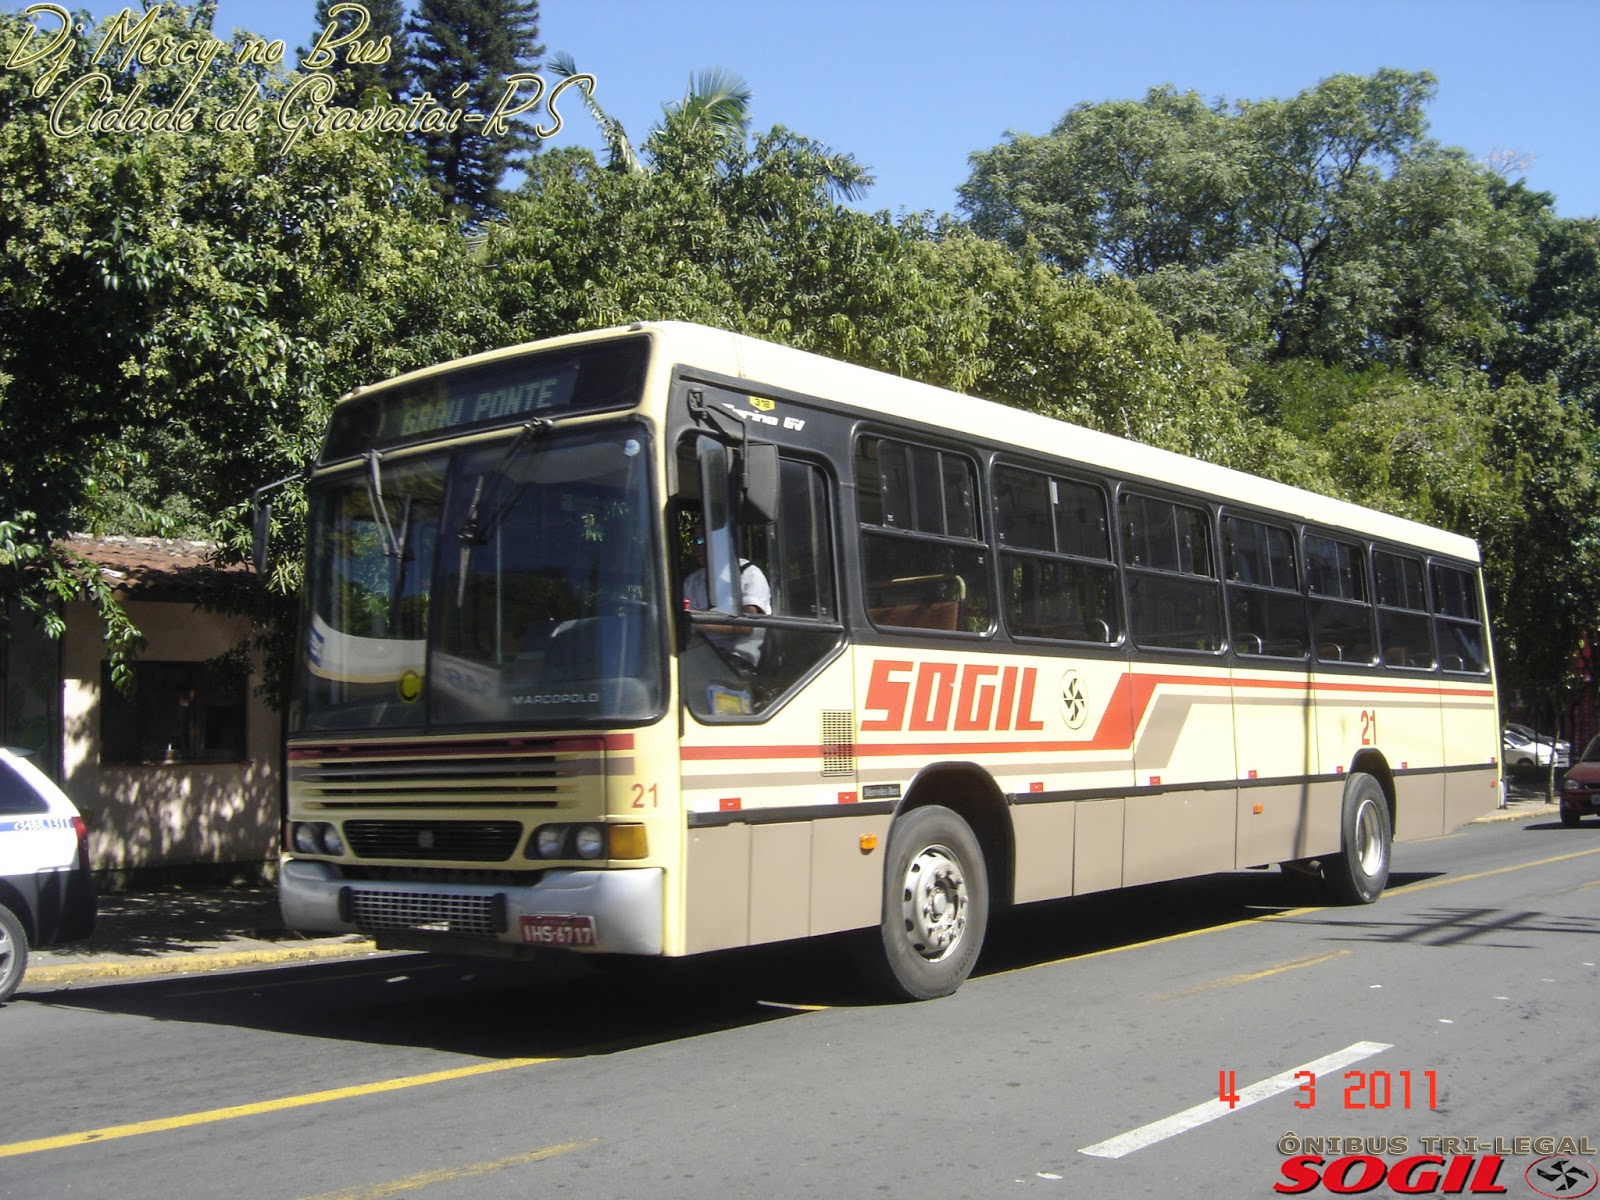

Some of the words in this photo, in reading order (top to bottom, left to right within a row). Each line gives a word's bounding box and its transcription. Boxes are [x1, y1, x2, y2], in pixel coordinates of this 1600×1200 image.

[472, 379, 558, 421] PONTE
[511, 693, 599, 705] MARCOPOLO
[860, 659, 1044, 731] SOGIL
[1360, 709, 1377, 745] 21
[631, 783, 658, 808] 21
